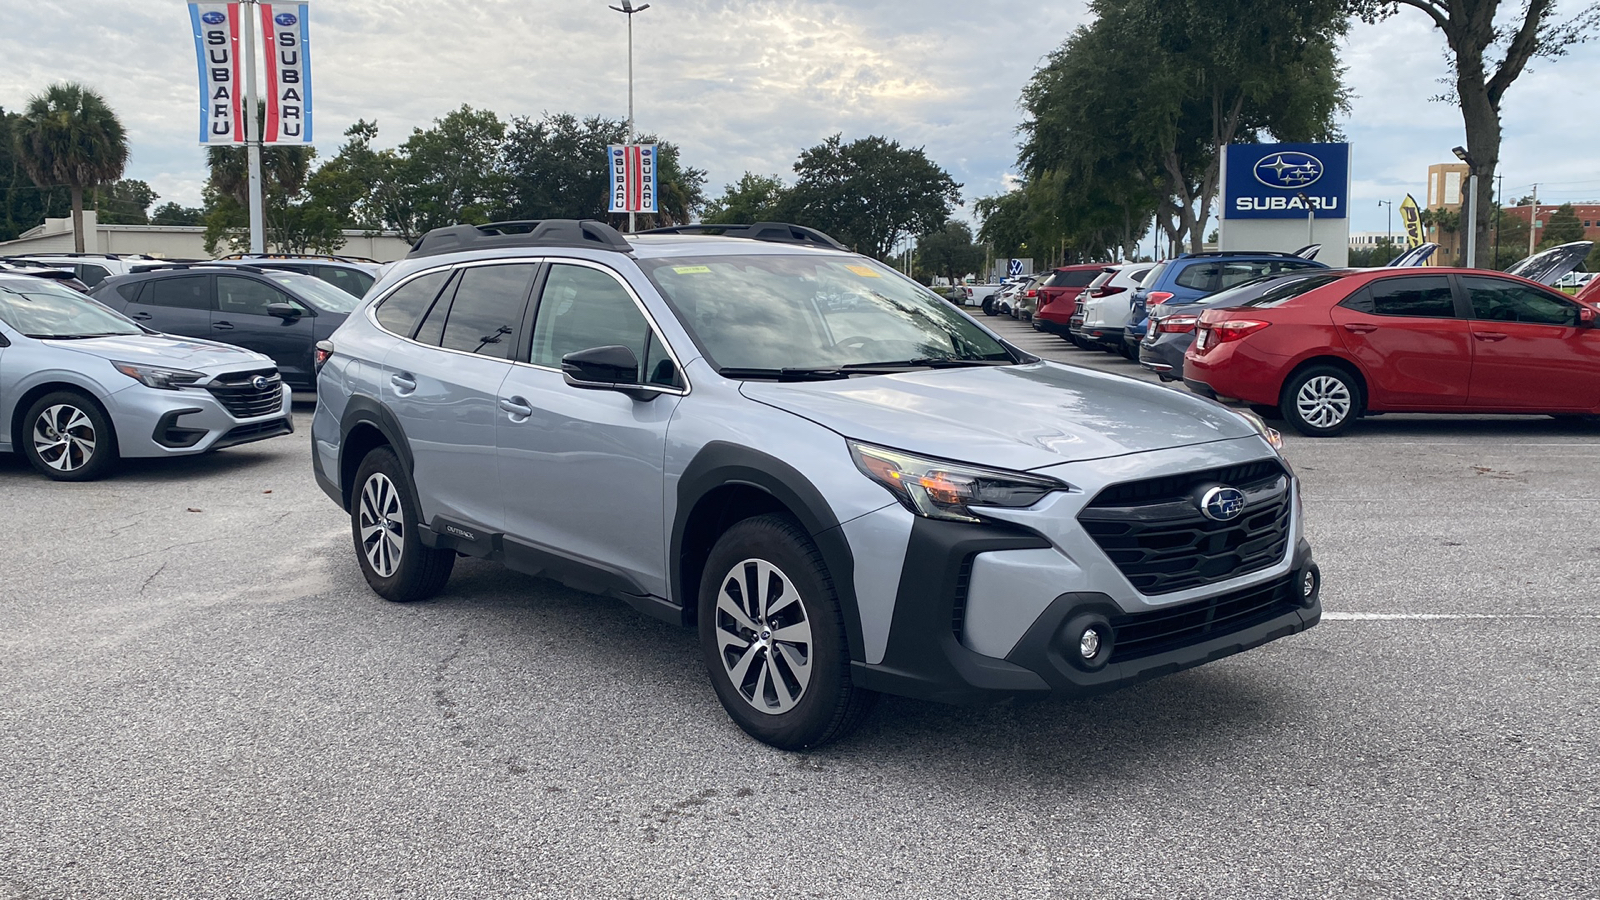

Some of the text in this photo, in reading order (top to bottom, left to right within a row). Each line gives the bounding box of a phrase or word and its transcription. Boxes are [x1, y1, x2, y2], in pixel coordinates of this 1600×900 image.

[207, 30, 230, 135] SUBARU
[279, 31, 301, 137] SUBARU
[615, 158, 625, 208] SUBARU
[642, 158, 652, 208] SUBARU
[1236, 196, 1338, 210] SUBARU
[446, 525, 475, 539] OUTBACK
